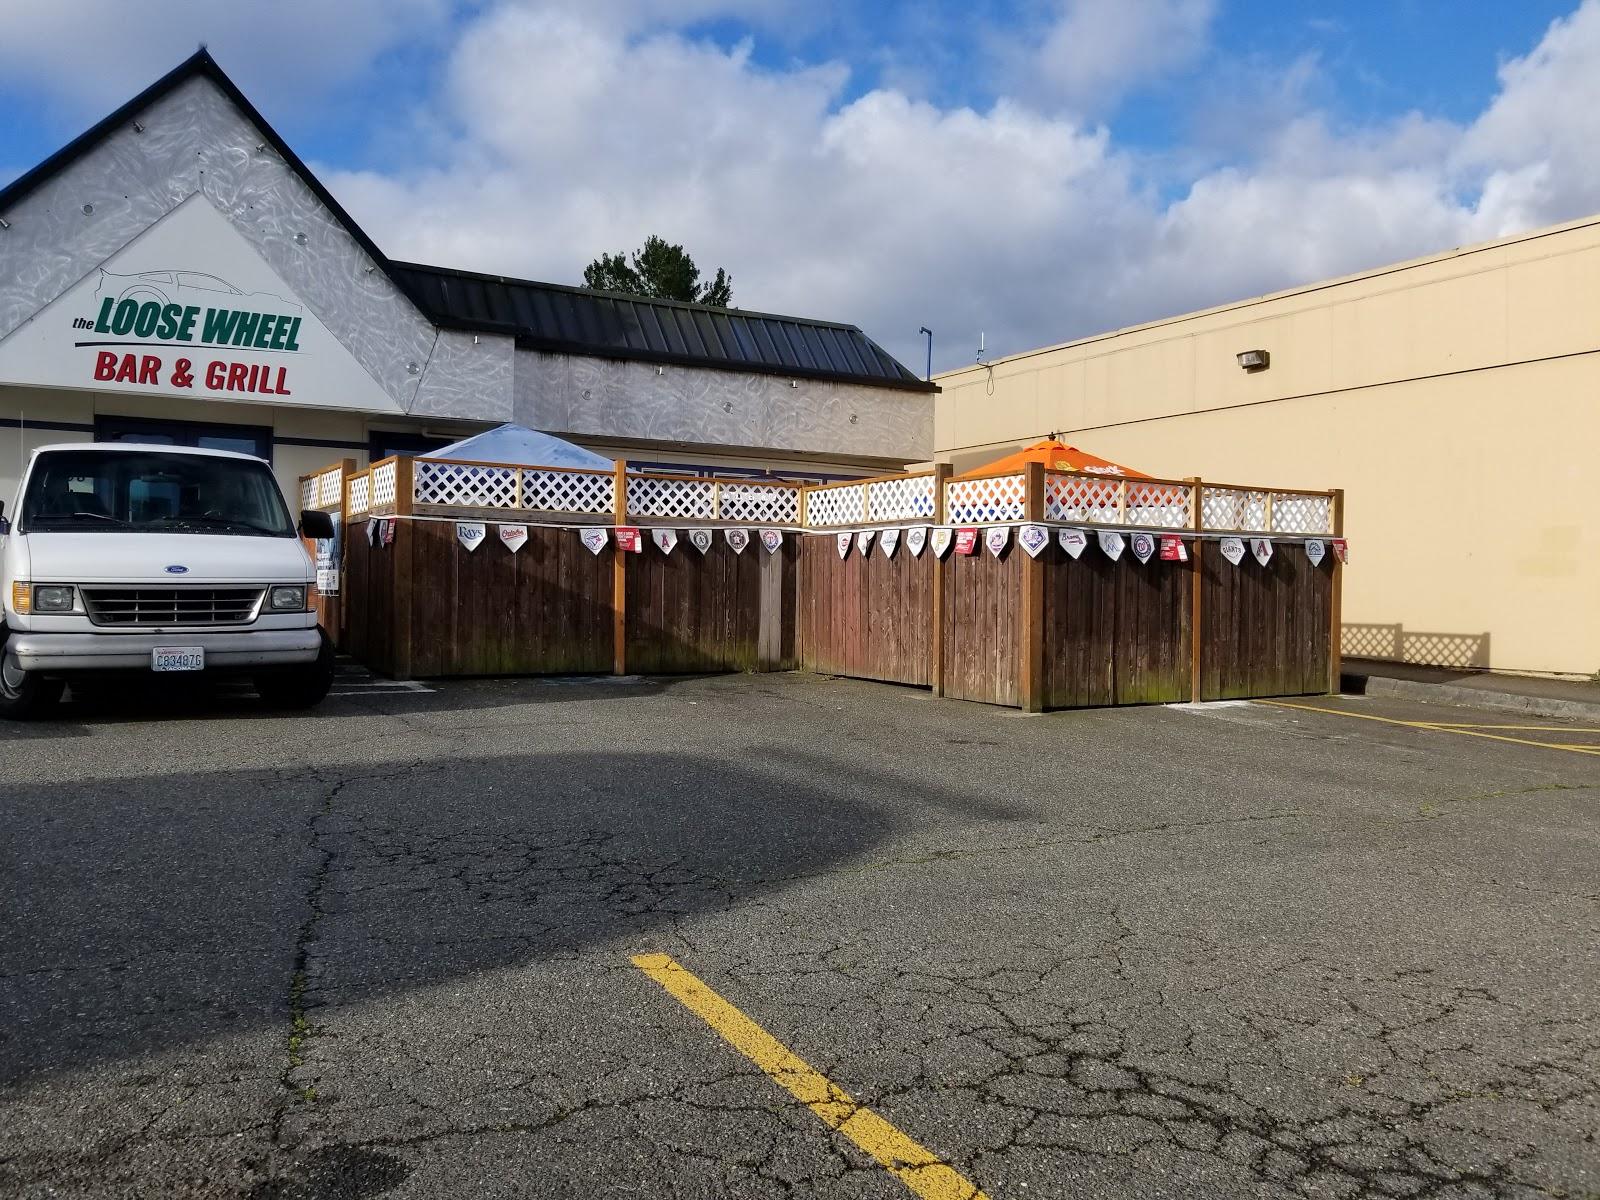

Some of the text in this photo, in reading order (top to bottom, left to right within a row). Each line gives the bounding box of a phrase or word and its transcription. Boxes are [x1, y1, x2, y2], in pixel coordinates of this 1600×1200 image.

[73, 296, 303, 352] the LOOSE WHEEL
[93, 350, 292, 396] BAR & GRILL
[157, 654, 201, 667] C83487G
